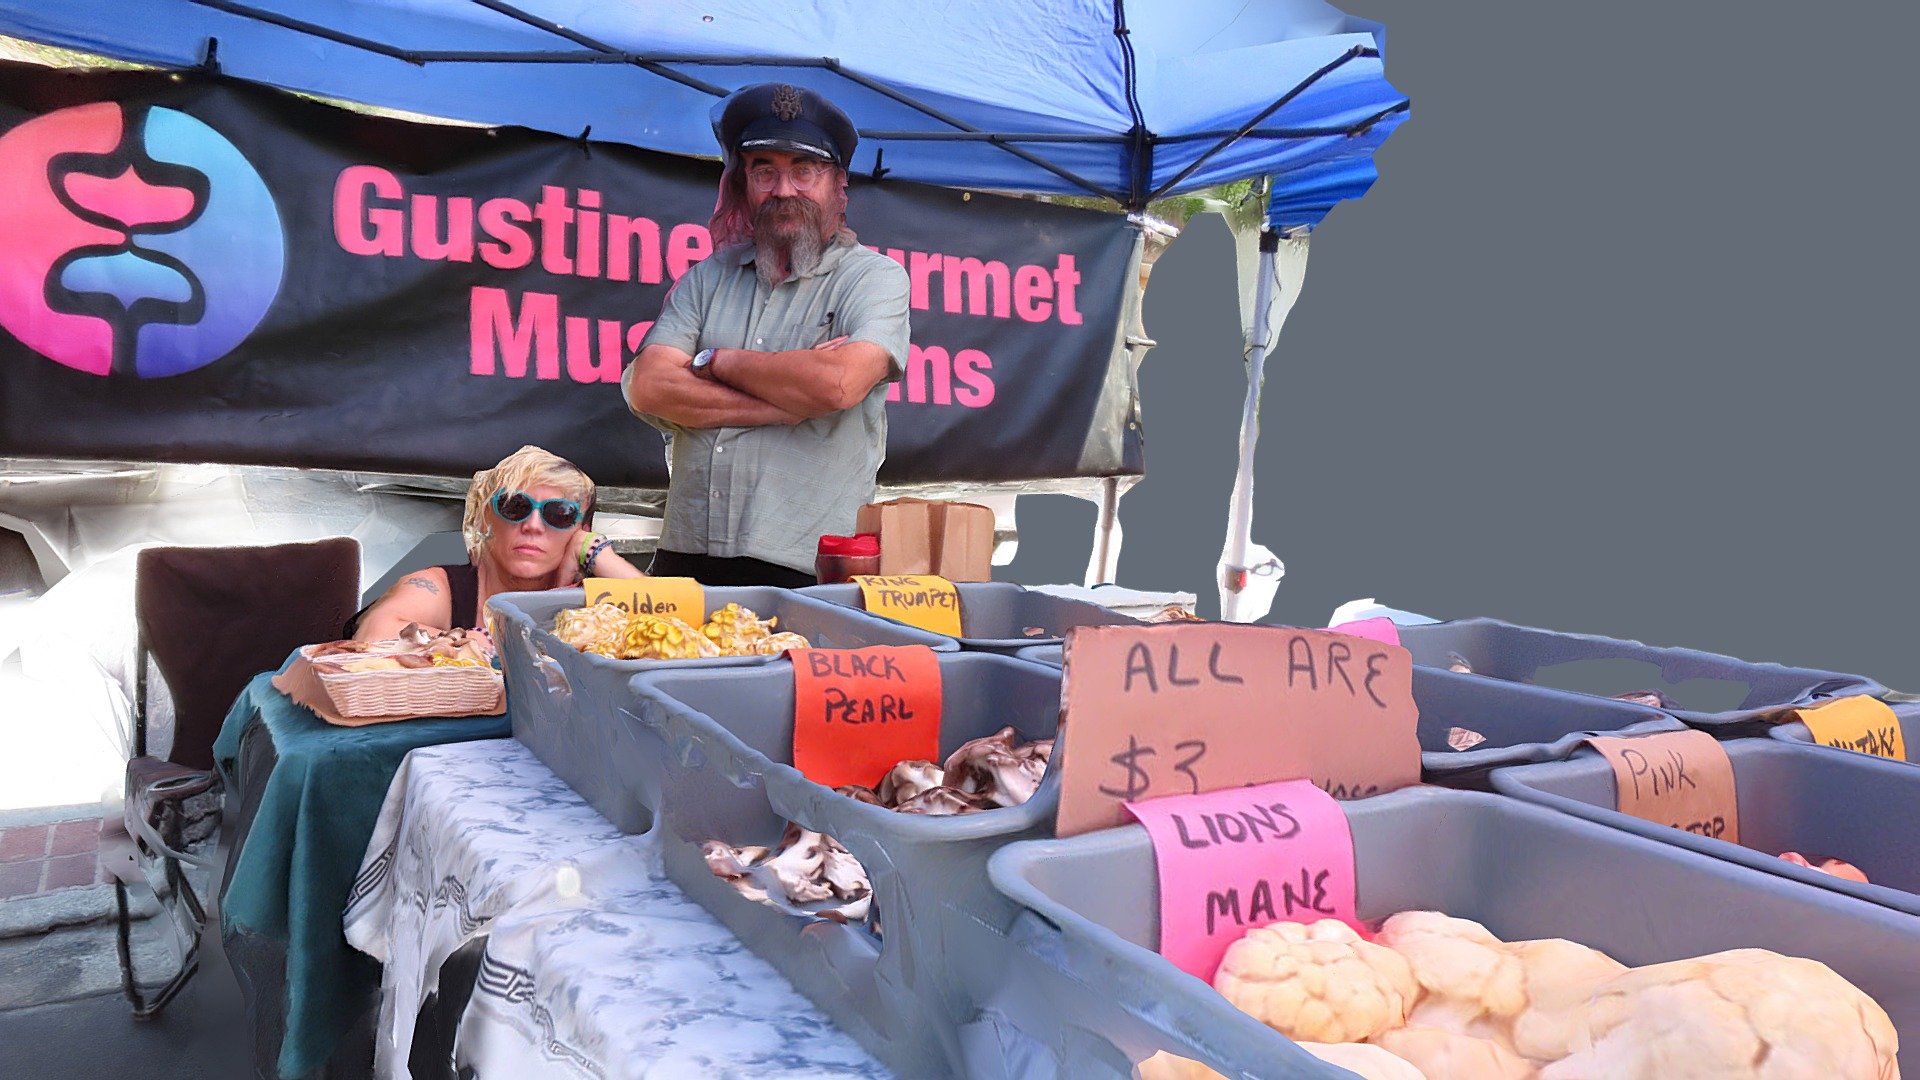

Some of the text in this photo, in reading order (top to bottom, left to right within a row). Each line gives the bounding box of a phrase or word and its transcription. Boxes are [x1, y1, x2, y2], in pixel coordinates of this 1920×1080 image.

[333, 165, 713, 285] Gustine
[862, 577, 920, 587] KING
[878, 588, 957, 612] TRUMPET
[808, 651, 906, 682] BLACK
[1124, 636, 1388, 709] ALL ARE
[824, 687, 914, 725] PEARL
[1620, 748, 1697, 800] PINK
[1171, 802, 1302, 849] LIONS
[1206, 867, 1336, 936] MANE
